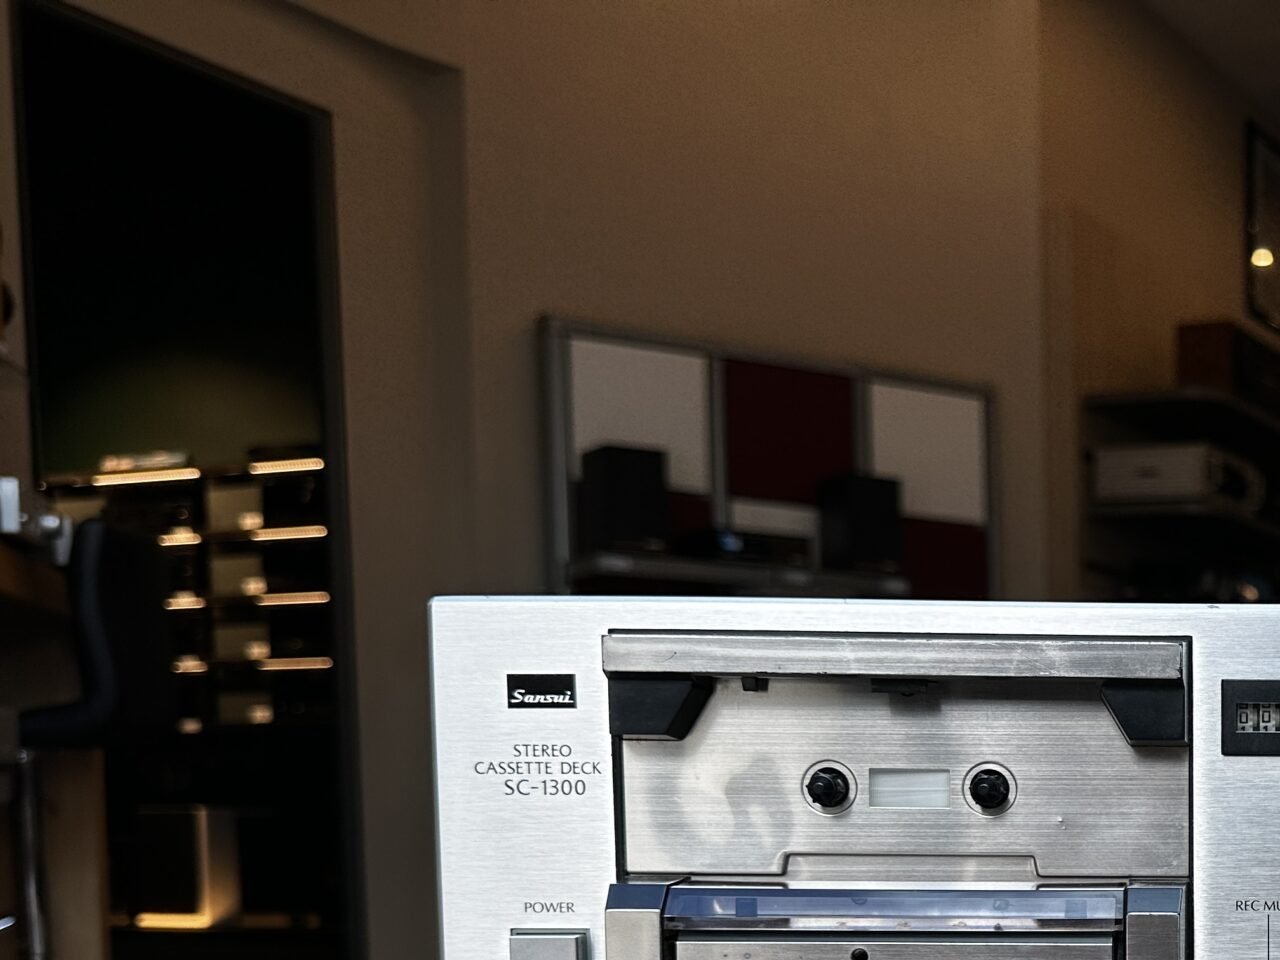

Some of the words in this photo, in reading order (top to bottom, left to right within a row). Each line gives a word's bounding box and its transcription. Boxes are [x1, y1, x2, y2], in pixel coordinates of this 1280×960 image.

[510, 688, 574, 704] Sansui
[512, 744, 572, 758] STEREO
[474, 760, 552, 776] CASSETTE
[560, 760, 602, 776] DECK
[504, 778, 586, 796] SC-1300
[524, 902, 576, 914] POWER
[1234, 900, 1260, 912] REC
